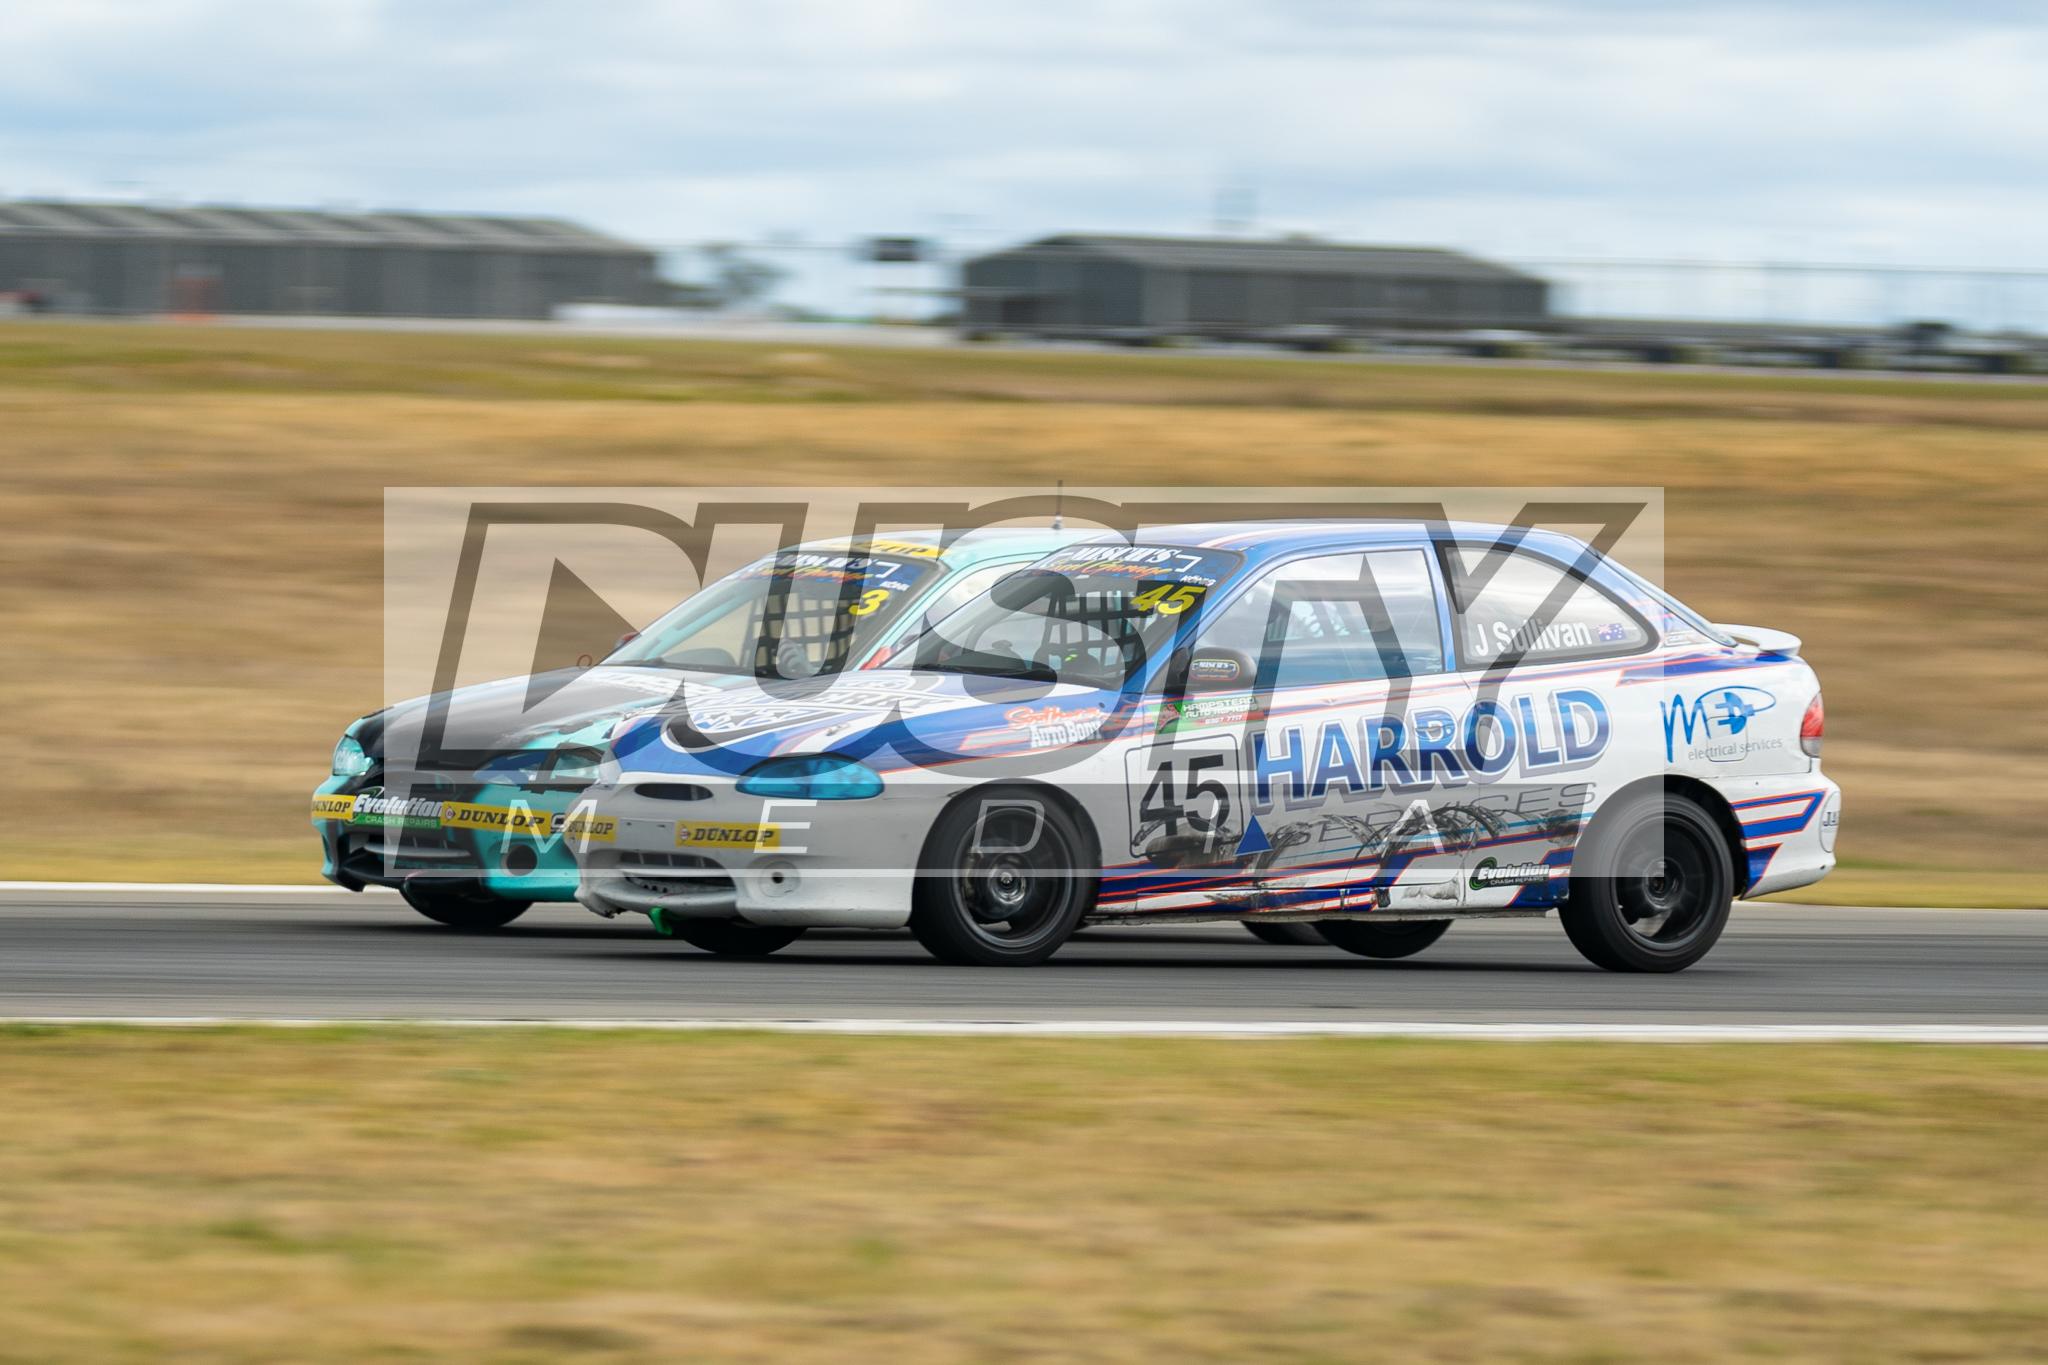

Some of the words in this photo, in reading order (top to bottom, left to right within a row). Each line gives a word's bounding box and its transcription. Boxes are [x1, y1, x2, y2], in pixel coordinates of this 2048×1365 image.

[848, 588, 889, 616] 3
[1130, 584, 1206, 615] 45
[1475, 623, 1489, 656] J
[1493, 619, 1593, 653] Sullivan
[1183, 697, 1256, 711] HAMPSTEAD
[1186, 709, 1213, 719] AUTO
[1250, 688, 1613, 807] HARROLD
[1687, 743, 1737, 761] electrical
[1740, 737, 1783, 753] services
[354, 793, 442, 818] Evolution
[1140, 754, 1230, 836] 45
[458, 809, 545, 829] DUNLOP
[692, 827, 774, 843] DUNLOP
[1478, 862, 1550, 880] Evolution
[1490, 878, 1514, 886] CRASH
